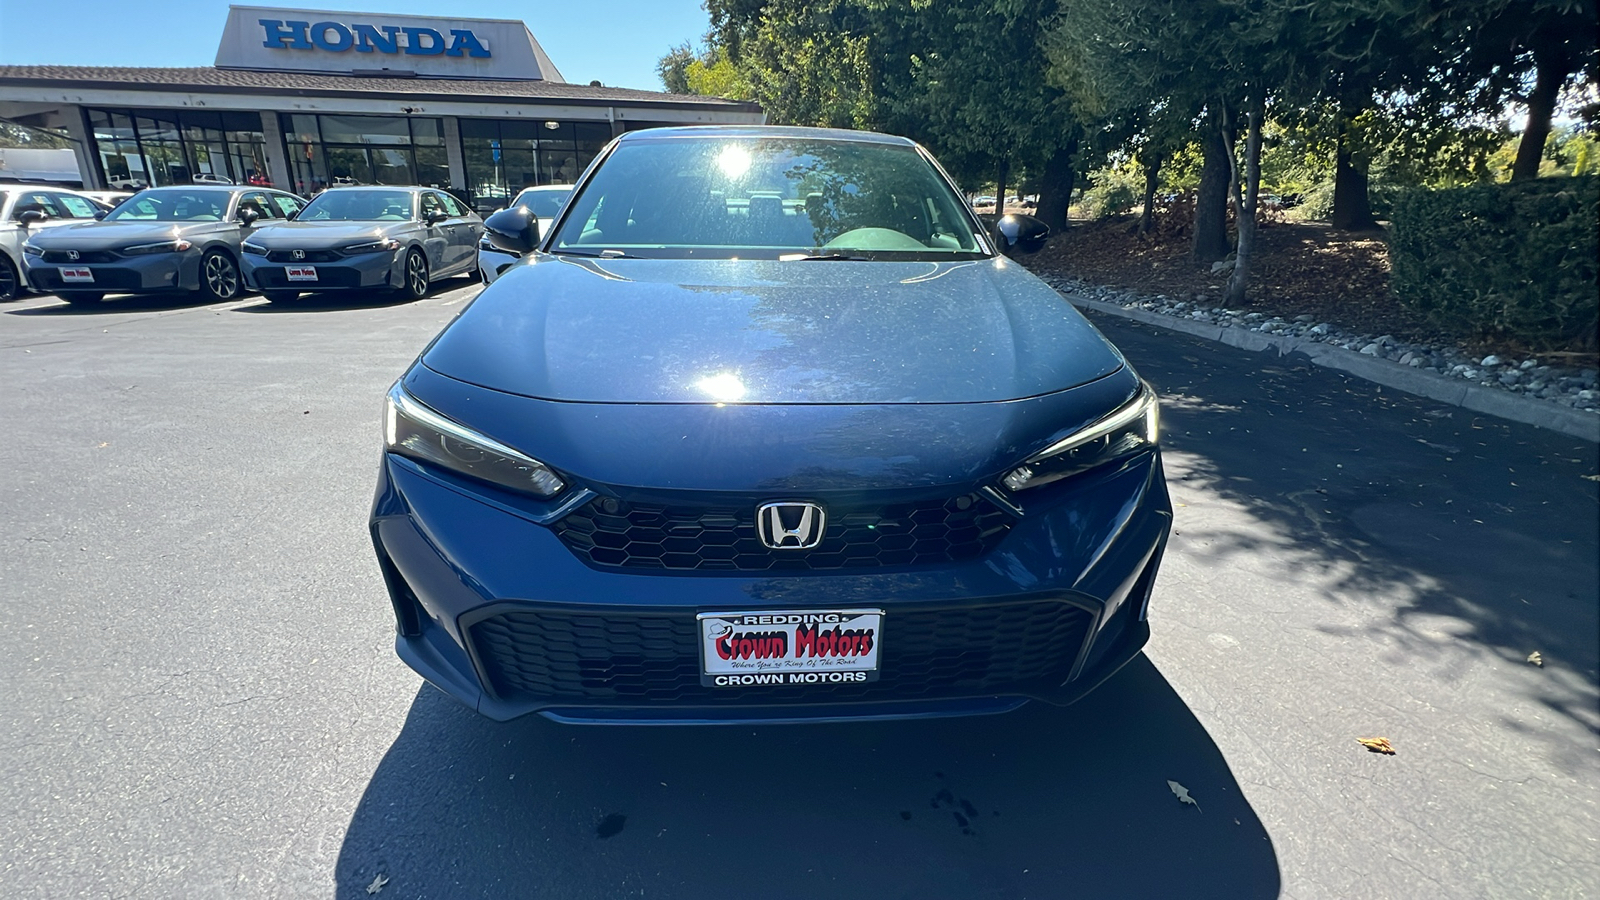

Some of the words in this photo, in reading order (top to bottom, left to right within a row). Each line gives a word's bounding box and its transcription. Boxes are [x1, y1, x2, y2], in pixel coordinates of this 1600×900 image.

[258, 19, 492, 58] HONDA
[743, 614, 839, 625] REDDING
[715, 625, 788, 660] Crown
[795, 623, 874, 659] Motors
[757, 660, 782, 670] You're
[784, 659, 803, 668] King
[806, 658, 817, 667] Of
[819, 658, 833, 667] The
[715, 673, 784, 686] CROWN
[789, 672, 867, 684] MOTORS
